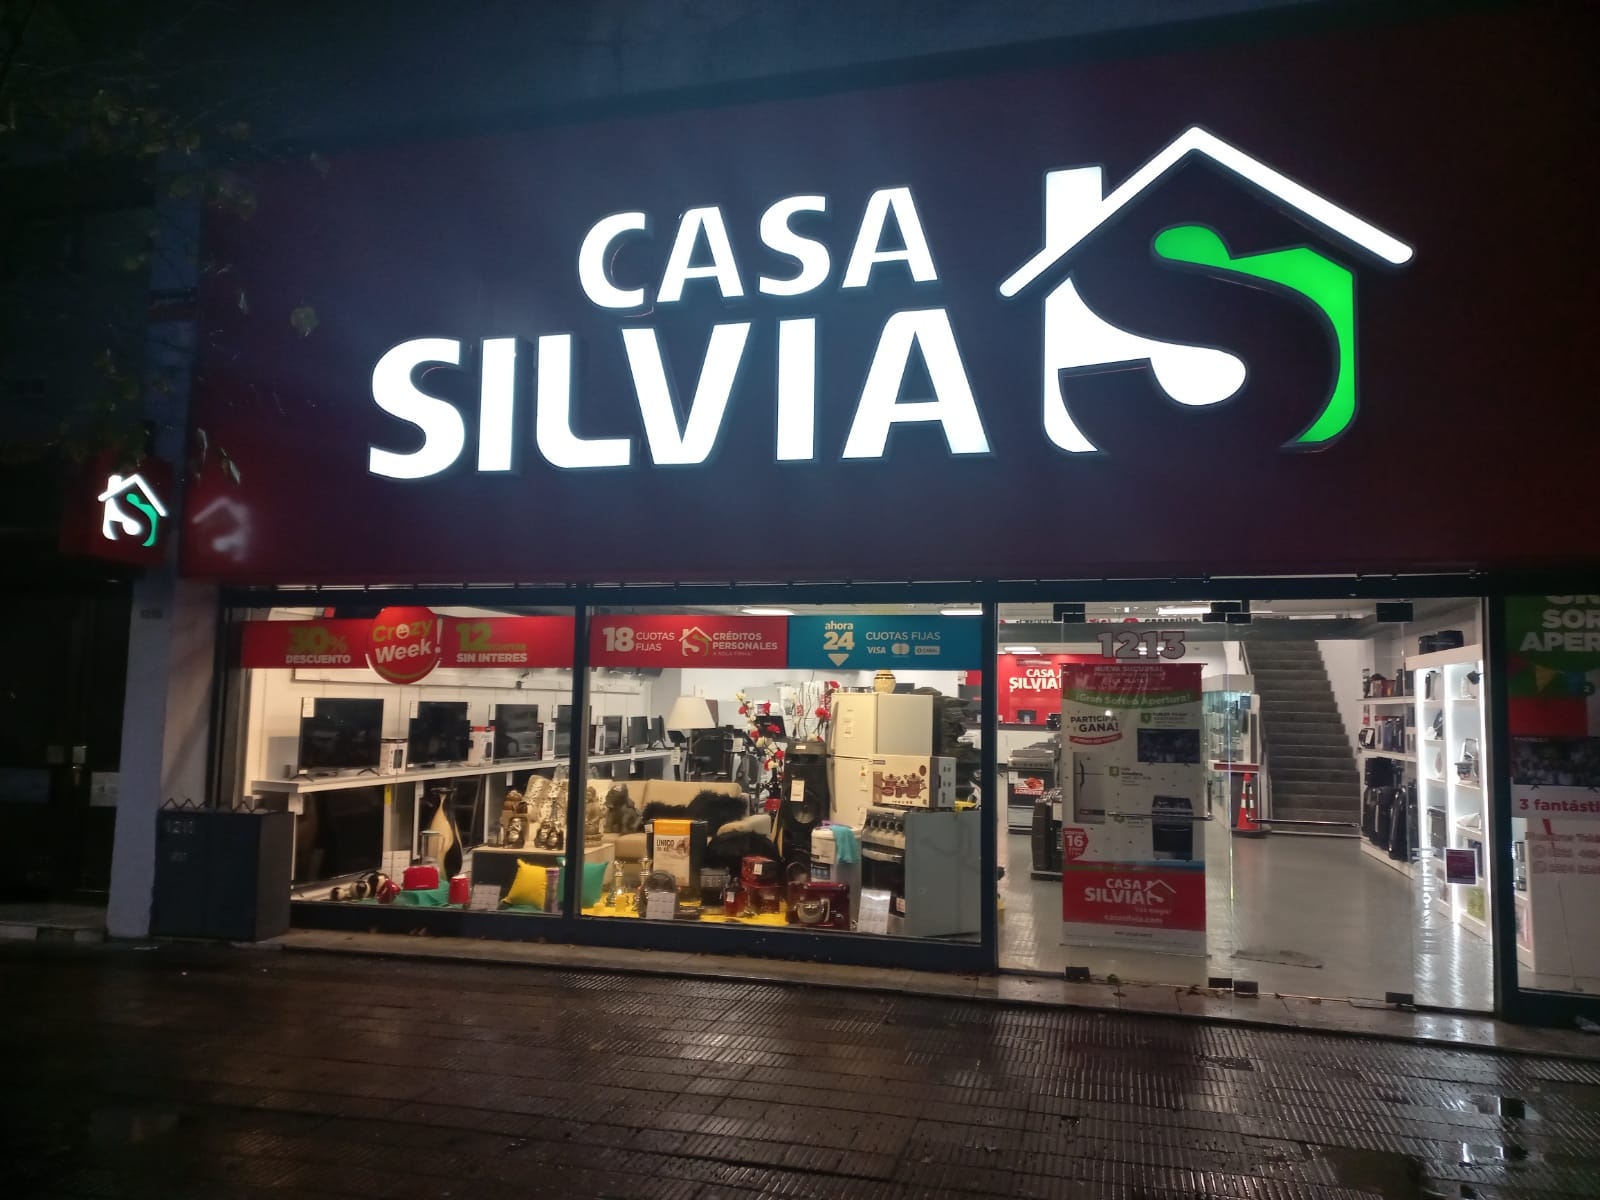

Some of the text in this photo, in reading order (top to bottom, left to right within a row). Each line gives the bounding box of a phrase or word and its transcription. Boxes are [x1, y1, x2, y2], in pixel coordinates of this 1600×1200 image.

[578, 186, 938, 309] CASA
[369, 308, 991, 479] SILVIA
[825, 620, 854, 630] ahora
[456, 622, 492, 651] 12
[603, 627, 635, 653] 18
[635, 632, 675, 641] CUOTAS
[712, 630, 762, 641] CRÉDITOS
[823, 631, 855, 651] 24
[865, 632, 941, 641] CUOTAS FIJAS
[635, 643, 662, 652] FIJAS
[712, 642, 778, 650] PERSONALES
[1097, 631, 1186, 660] 1213
[1520, 632, 1600, 652] APER
[867, 646, 886, 654] VISA
[286, 654, 351, 664] DESCUENTO
[456, 653, 528, 663] SIN INTERES
[1026, 668, 1055, 678] CASA
[1009, 677, 1059, 690] SILVIA
[1070, 714, 1118, 724] PARTICIPA
[1079, 723, 1119, 733] GANA!
[1519, 798, 1529, 810] 3
[1066, 835, 1084, 848] 16
[1106, 878, 1142, 889] CASA
[1084, 887, 1145, 905] SILVIA
